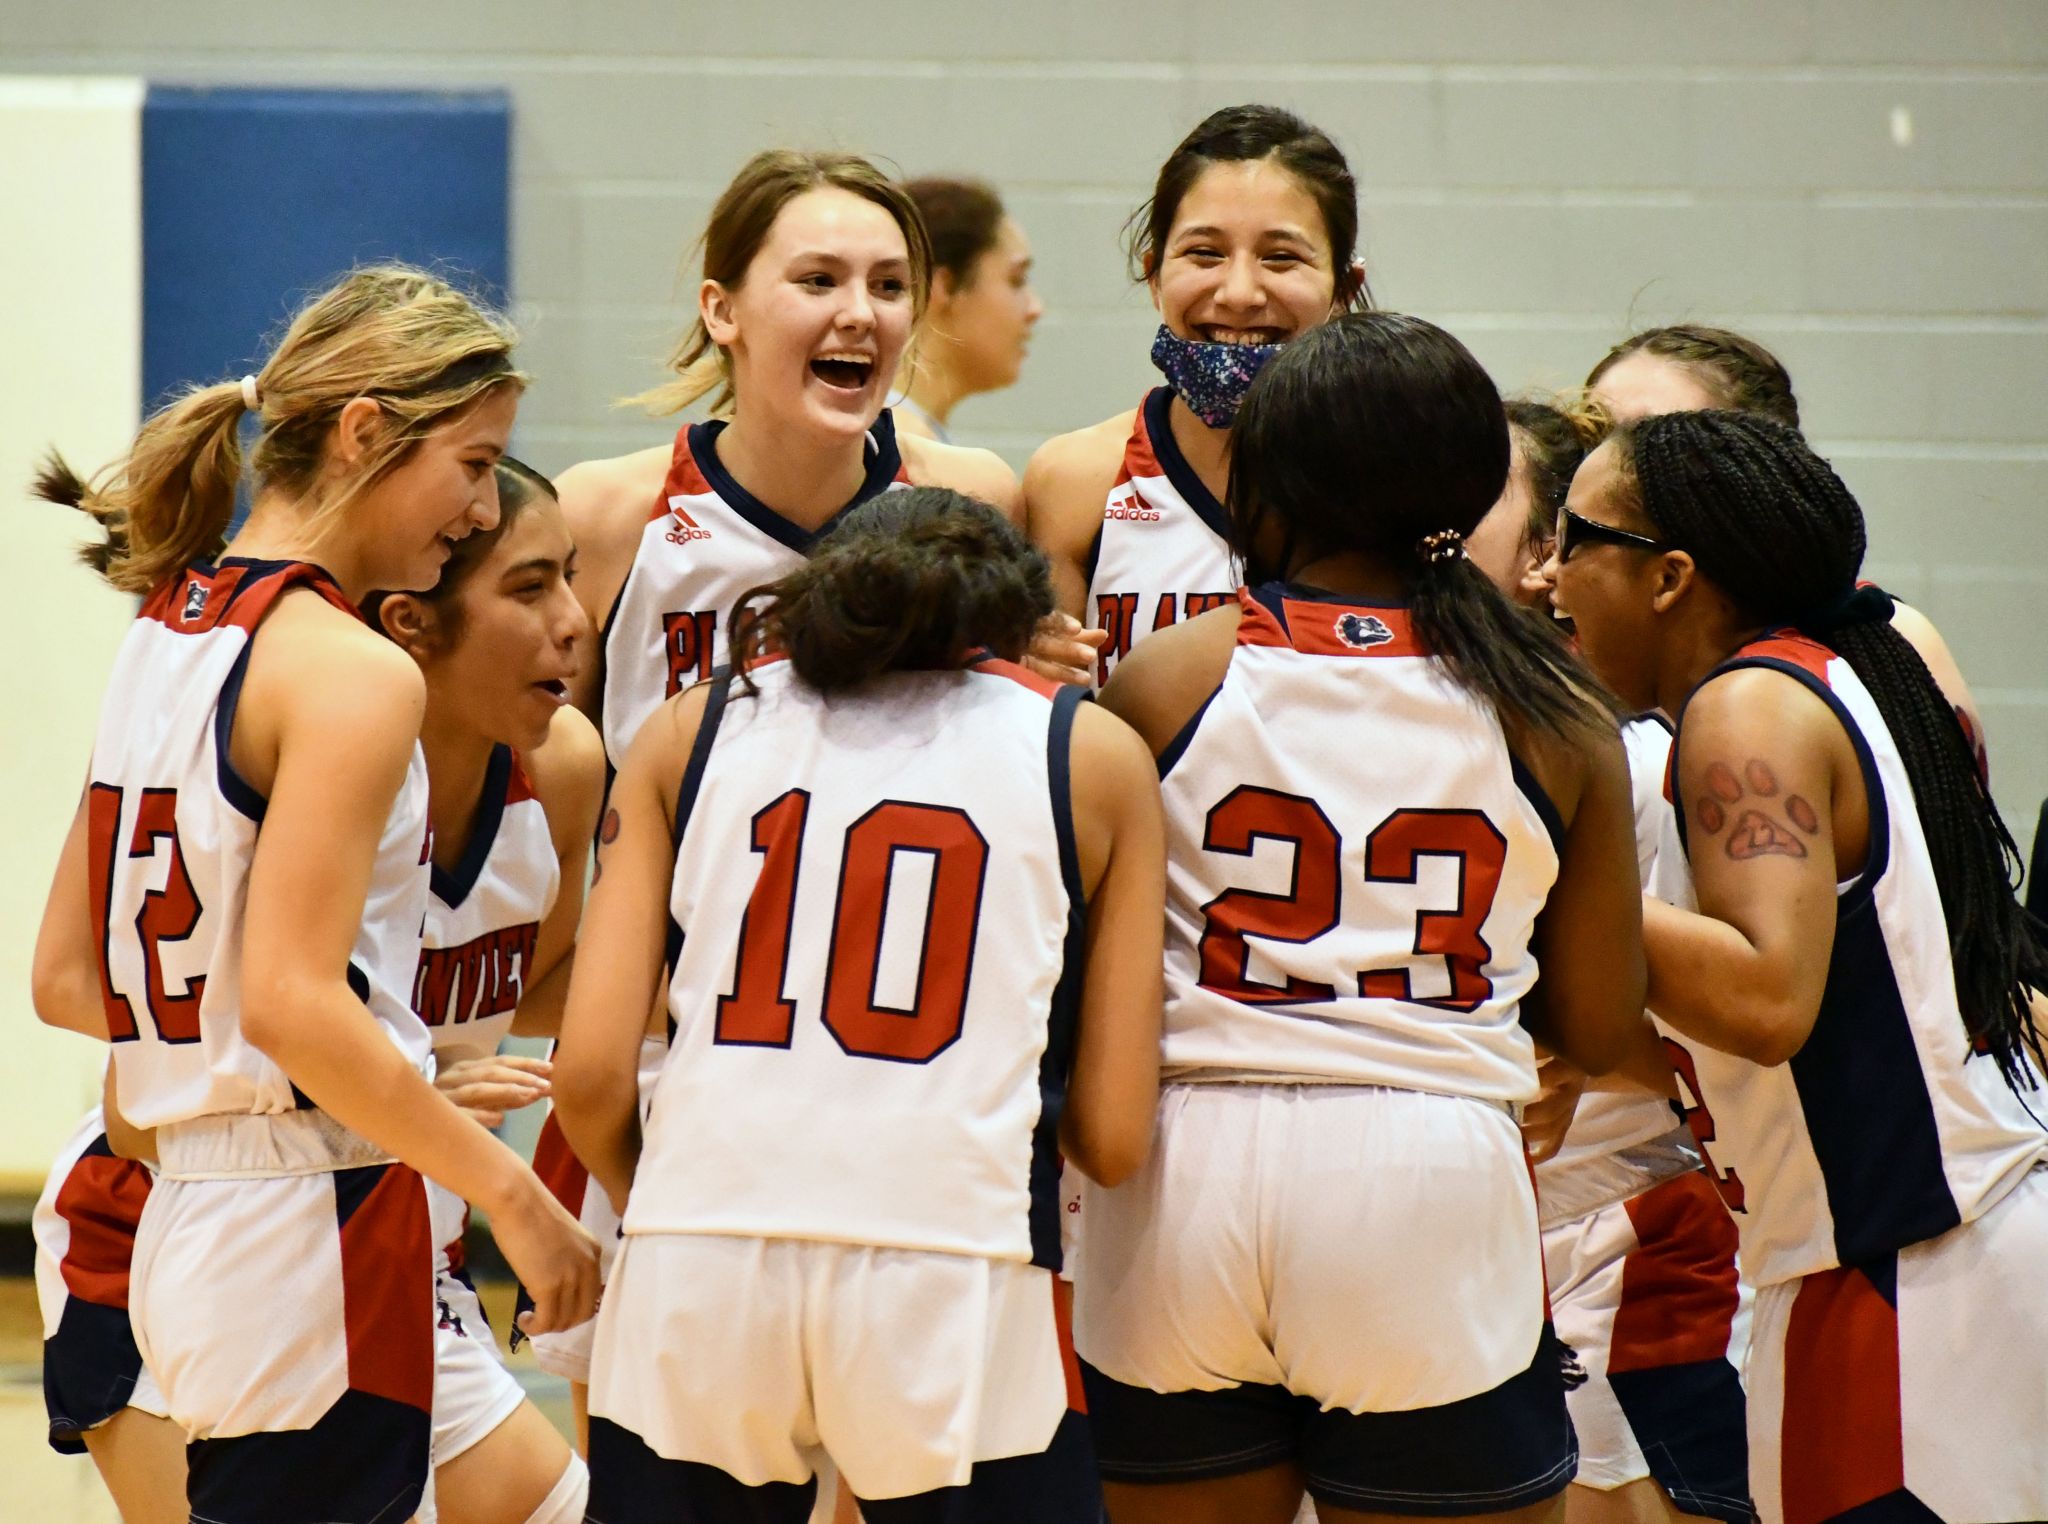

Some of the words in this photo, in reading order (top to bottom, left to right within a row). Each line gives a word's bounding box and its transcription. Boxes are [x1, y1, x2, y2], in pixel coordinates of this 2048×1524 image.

[1104, 507, 1160, 521] adidas
[88, 782, 207, 1044] 12
[713, 787, 990, 1065] 10
[1195, 784, 1508, 1014] 23
